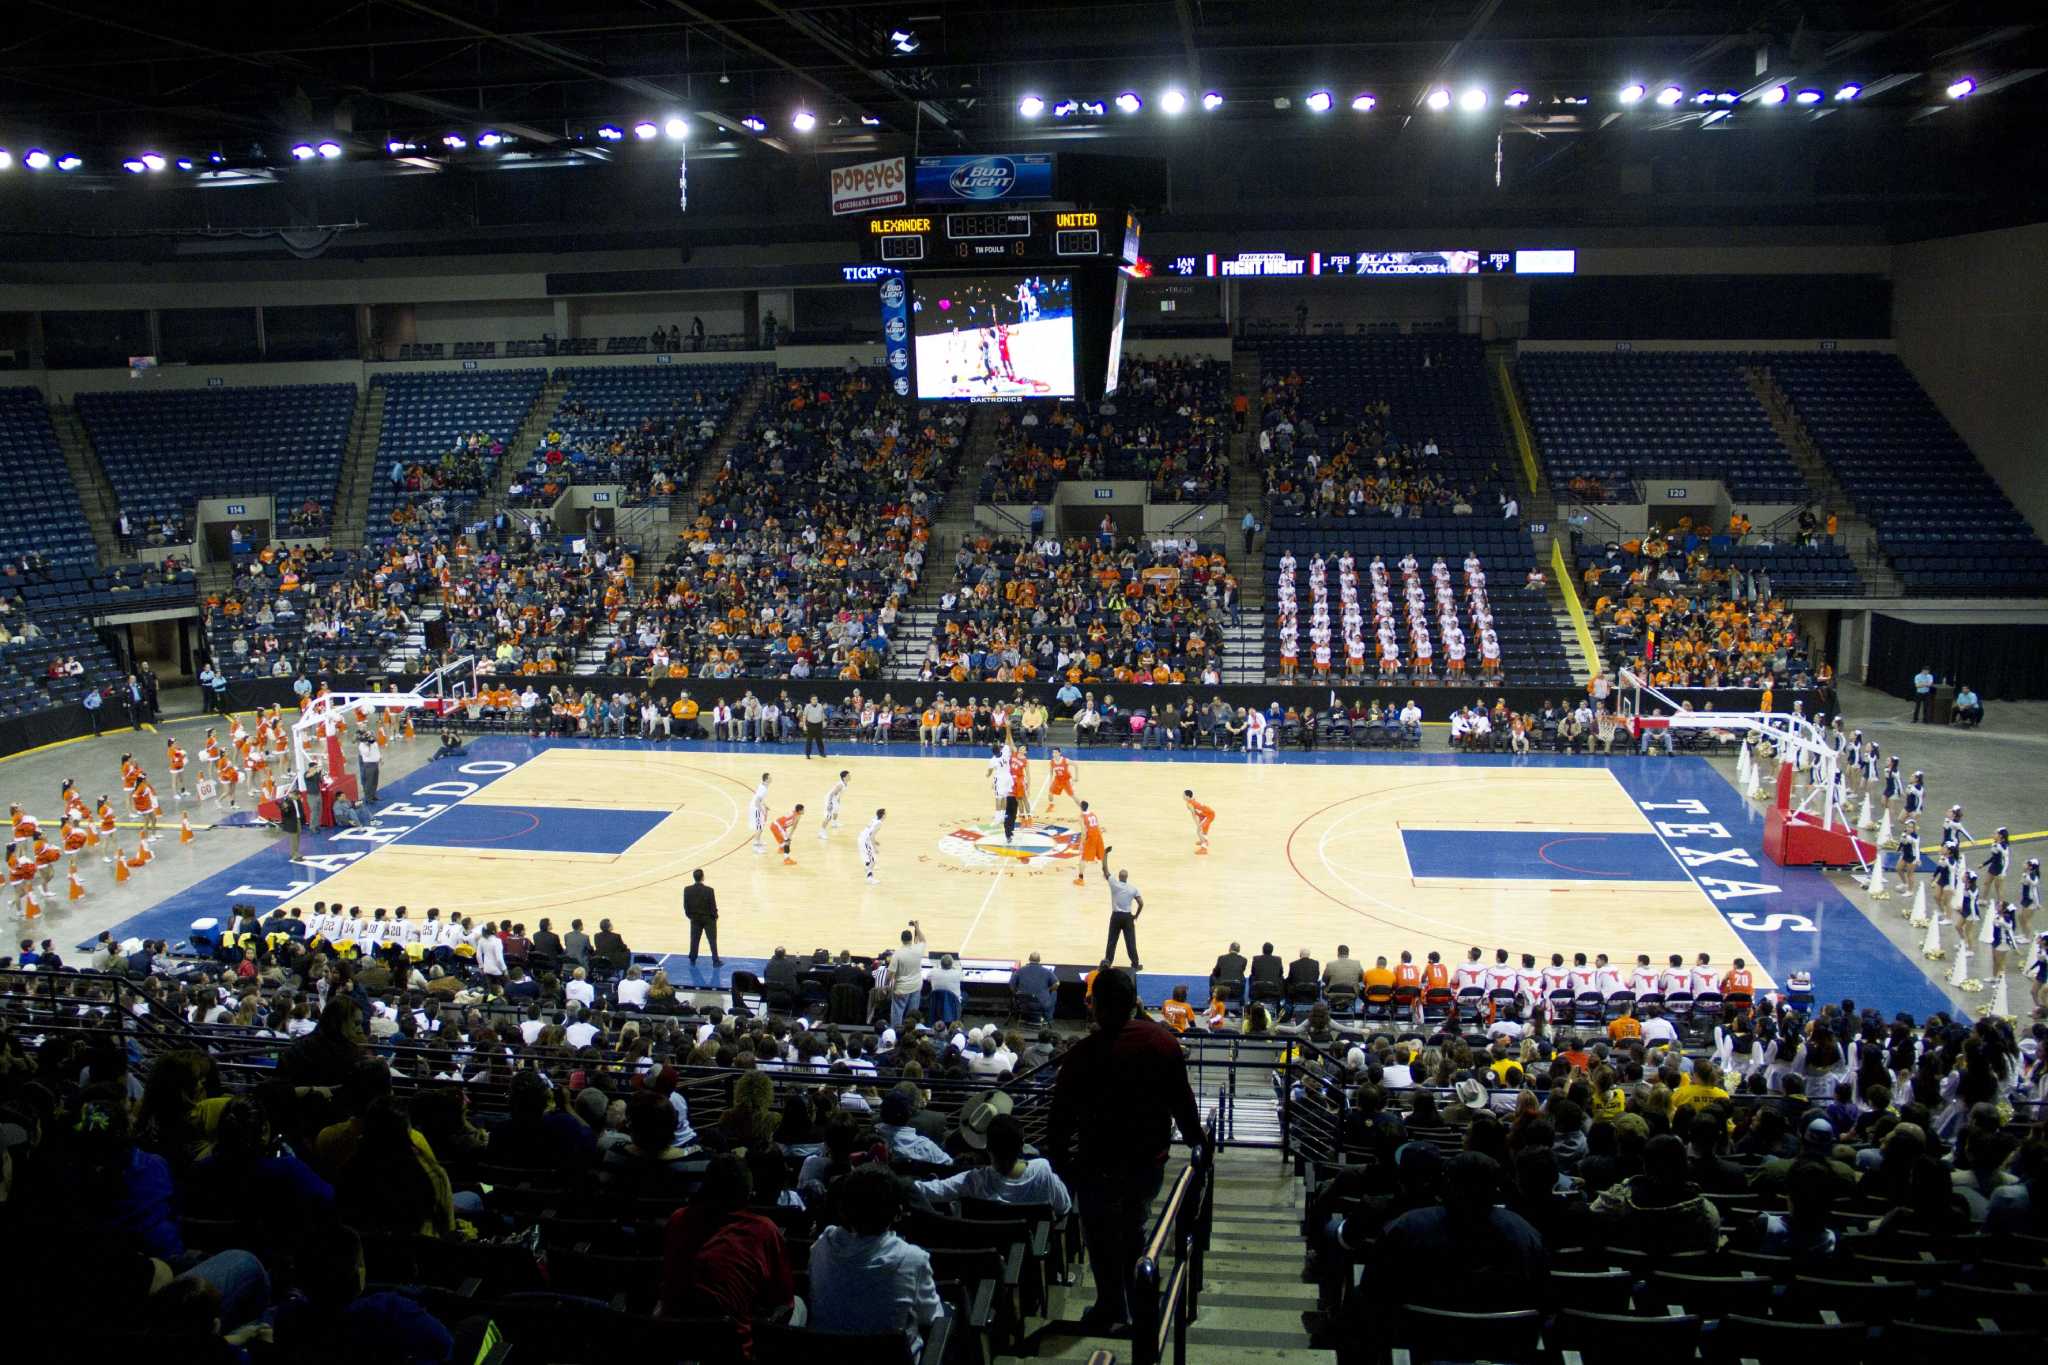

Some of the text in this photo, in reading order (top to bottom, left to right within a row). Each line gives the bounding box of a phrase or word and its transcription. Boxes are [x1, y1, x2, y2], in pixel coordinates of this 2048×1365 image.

[969, 166, 1008, 177] BUD
[962, 177, 1012, 188] LIGHT
[1056, 212, 1097, 227] UNITED
[870, 218, 931, 233] ALEXANDER
[1177, 257, 1195, 268] JAN
[1330, 256, 1350, 265] FEB
[1357, 253, 1403, 263] ALAN
[1490, 254, 1510, 263] FEB
[1180, 266, 1193, 275] 24
[1221, 260, 1305, 275] FIGHT NIGHT
[1366, 263, 1440, 274] JACKSON
[1669, 490, 1685, 498] 120
[229, 505, 243, 514] 114
[1530, 524, 1545, 533] 119
[200, 783, 213, 795] GO
[226, 760, 517, 900] LAREDO
[1639, 799, 1819, 932] TEXAS
[1402, 968, 1415, 980] 10
[1433, 967, 1442, 978] 11
[1735, 974, 1749, 986] 20
